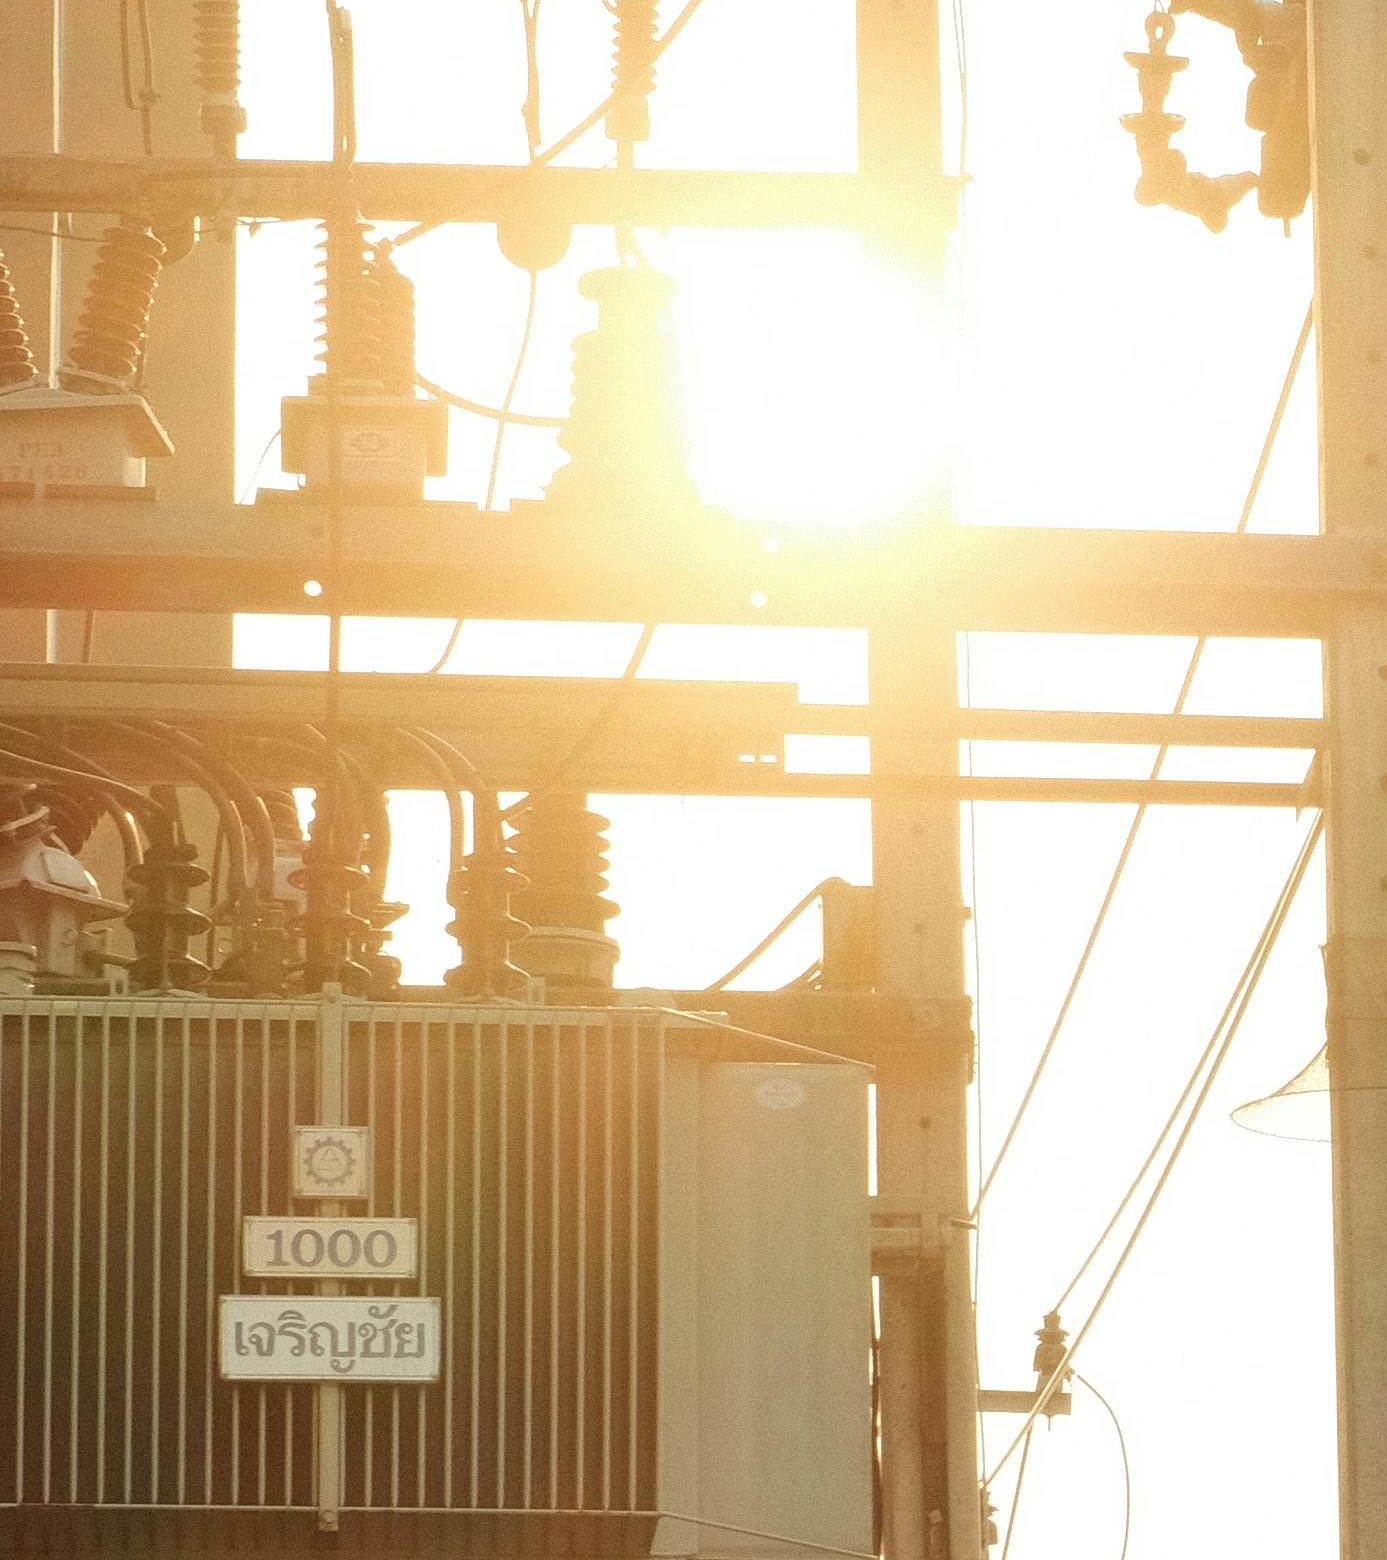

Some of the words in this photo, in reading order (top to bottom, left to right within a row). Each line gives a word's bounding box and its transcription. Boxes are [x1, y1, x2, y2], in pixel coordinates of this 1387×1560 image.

[265, 1228, 397, 1268] 1000
[234, 1304, 425, 1373] เจริญชัย
